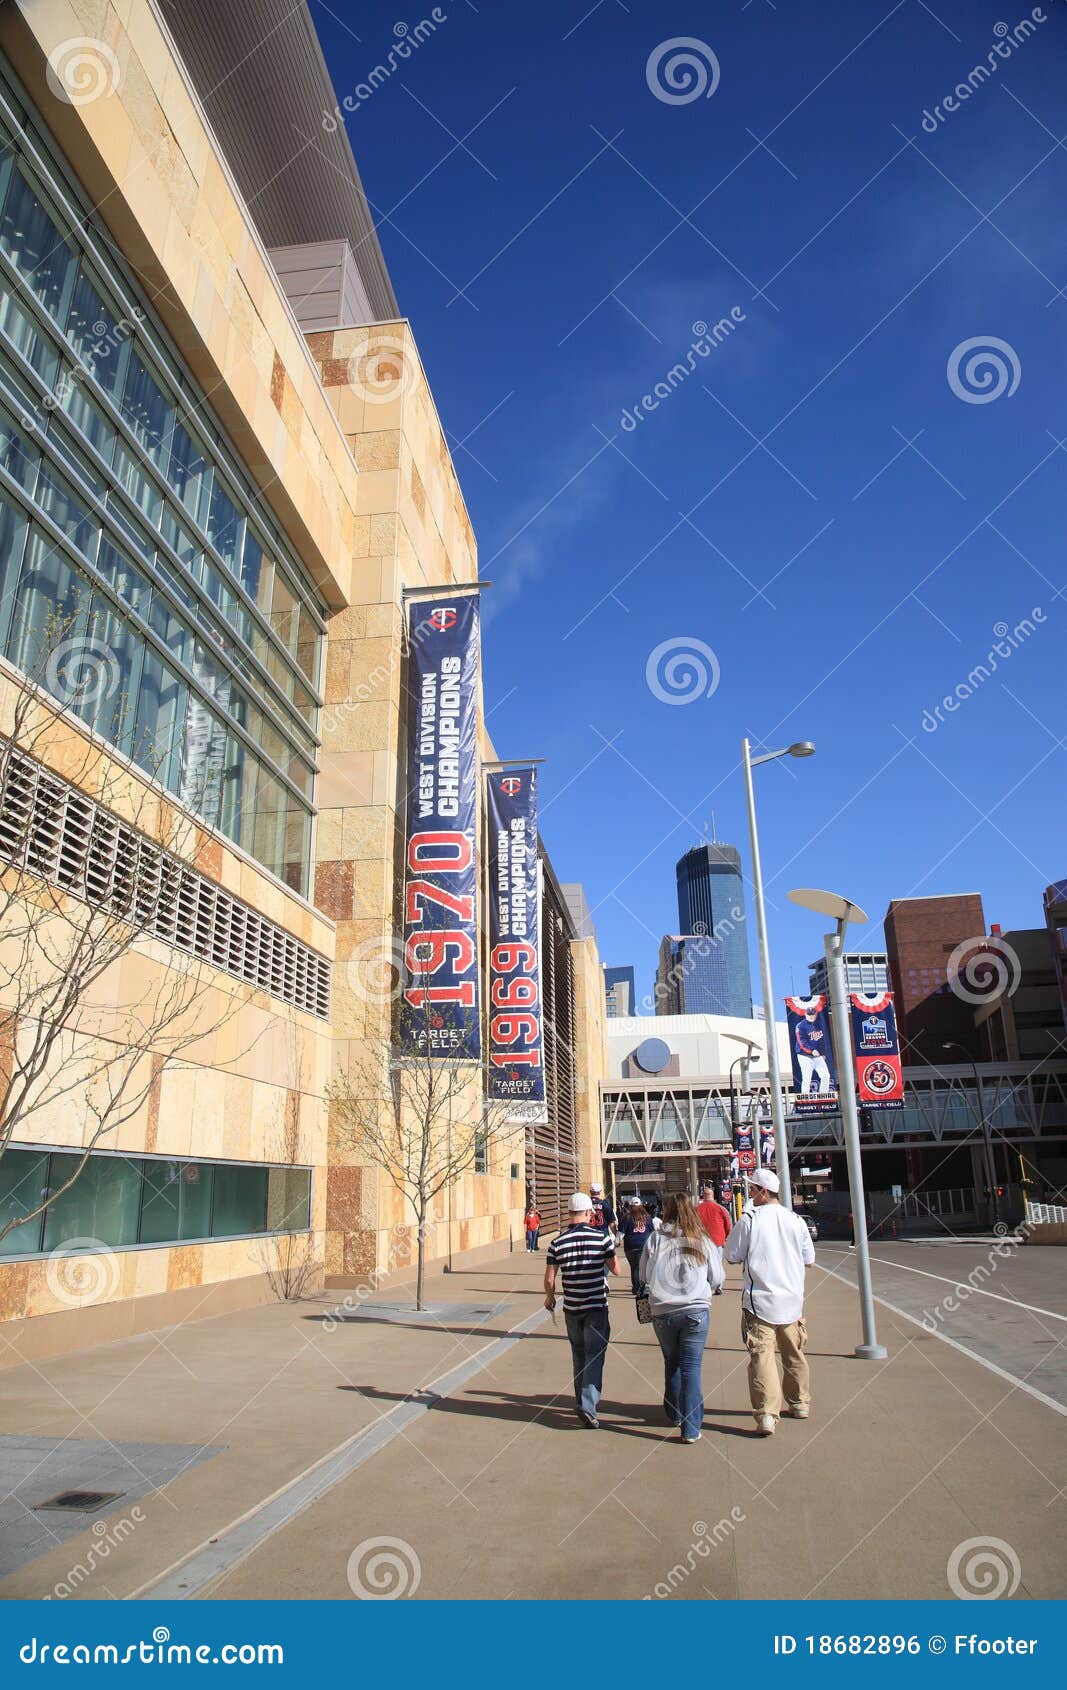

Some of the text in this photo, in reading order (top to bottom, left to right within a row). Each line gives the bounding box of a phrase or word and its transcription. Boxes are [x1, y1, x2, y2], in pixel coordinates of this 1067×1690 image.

[418, 672, 437, 818] WEST DIVISION
[438, 656, 462, 817] CHAMPIONS
[403, 830, 476, 1008] 1970
[498, 830, 509, 936] WEST DIVISION
[511, 818, 527, 936] CHAMPIONS
[410, 1029, 467, 1039] TARGET
[418, 1039, 460, 1049] FELD
[490, 942, 541, 1068] 1969
[495, 1080, 535, 1088] TARGET
[873, 1071, 888, 1085] 50
